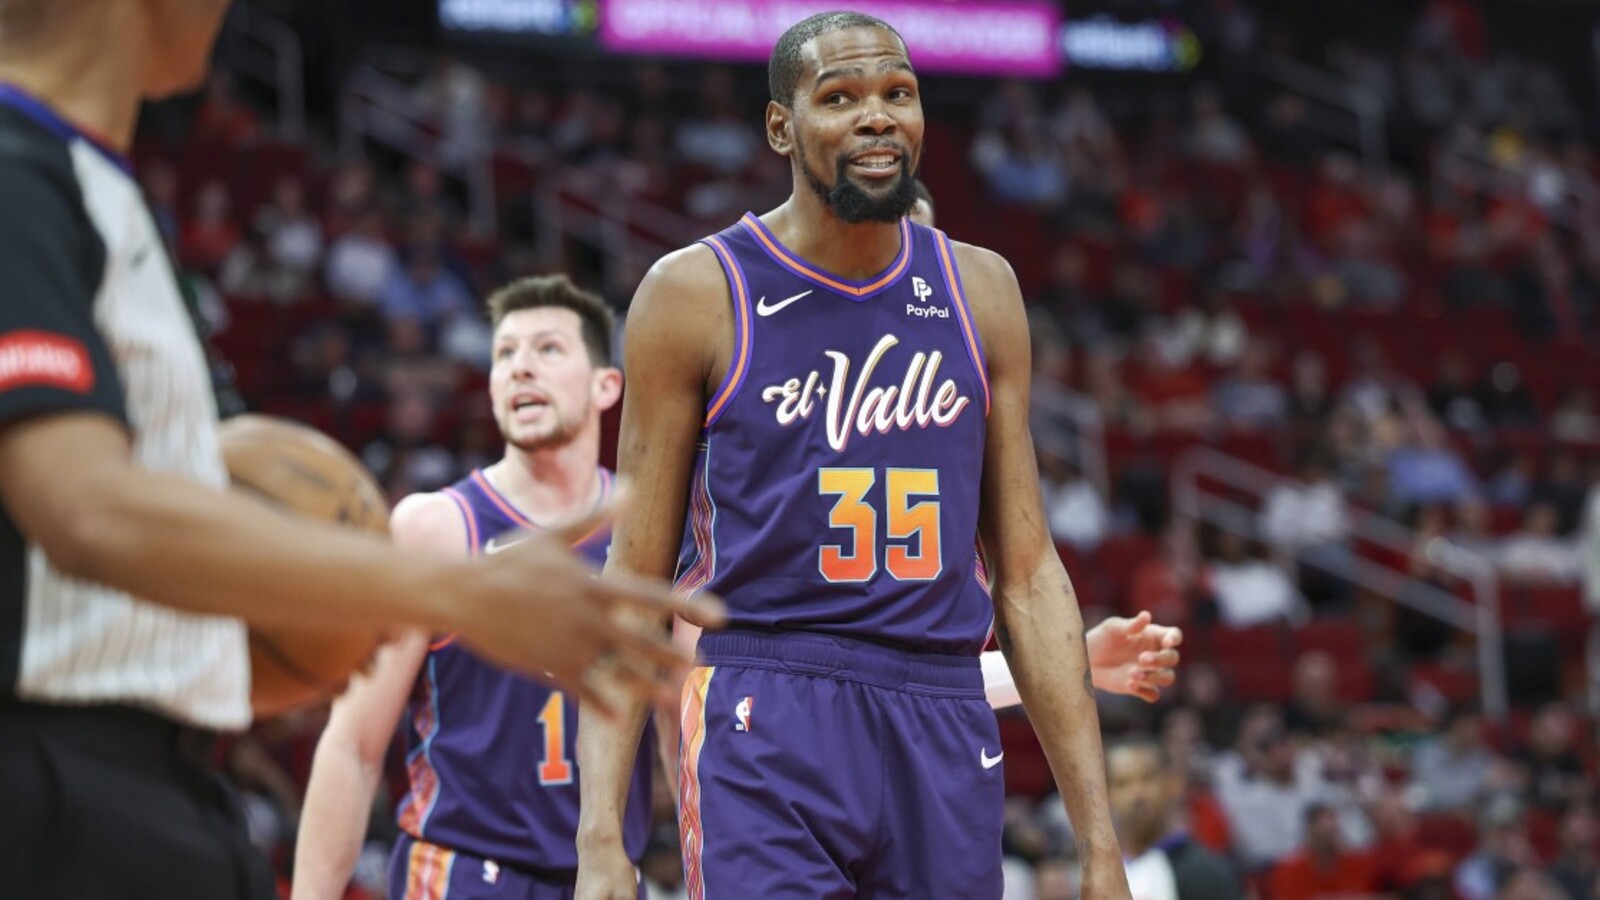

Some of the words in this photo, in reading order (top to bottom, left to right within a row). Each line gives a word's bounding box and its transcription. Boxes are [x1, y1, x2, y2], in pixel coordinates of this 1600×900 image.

[906, 303, 950, 319] PayPal
[762, 370, 819, 427] El
[824, 333, 970, 452] Valle
[818, 467, 943, 583] 35
